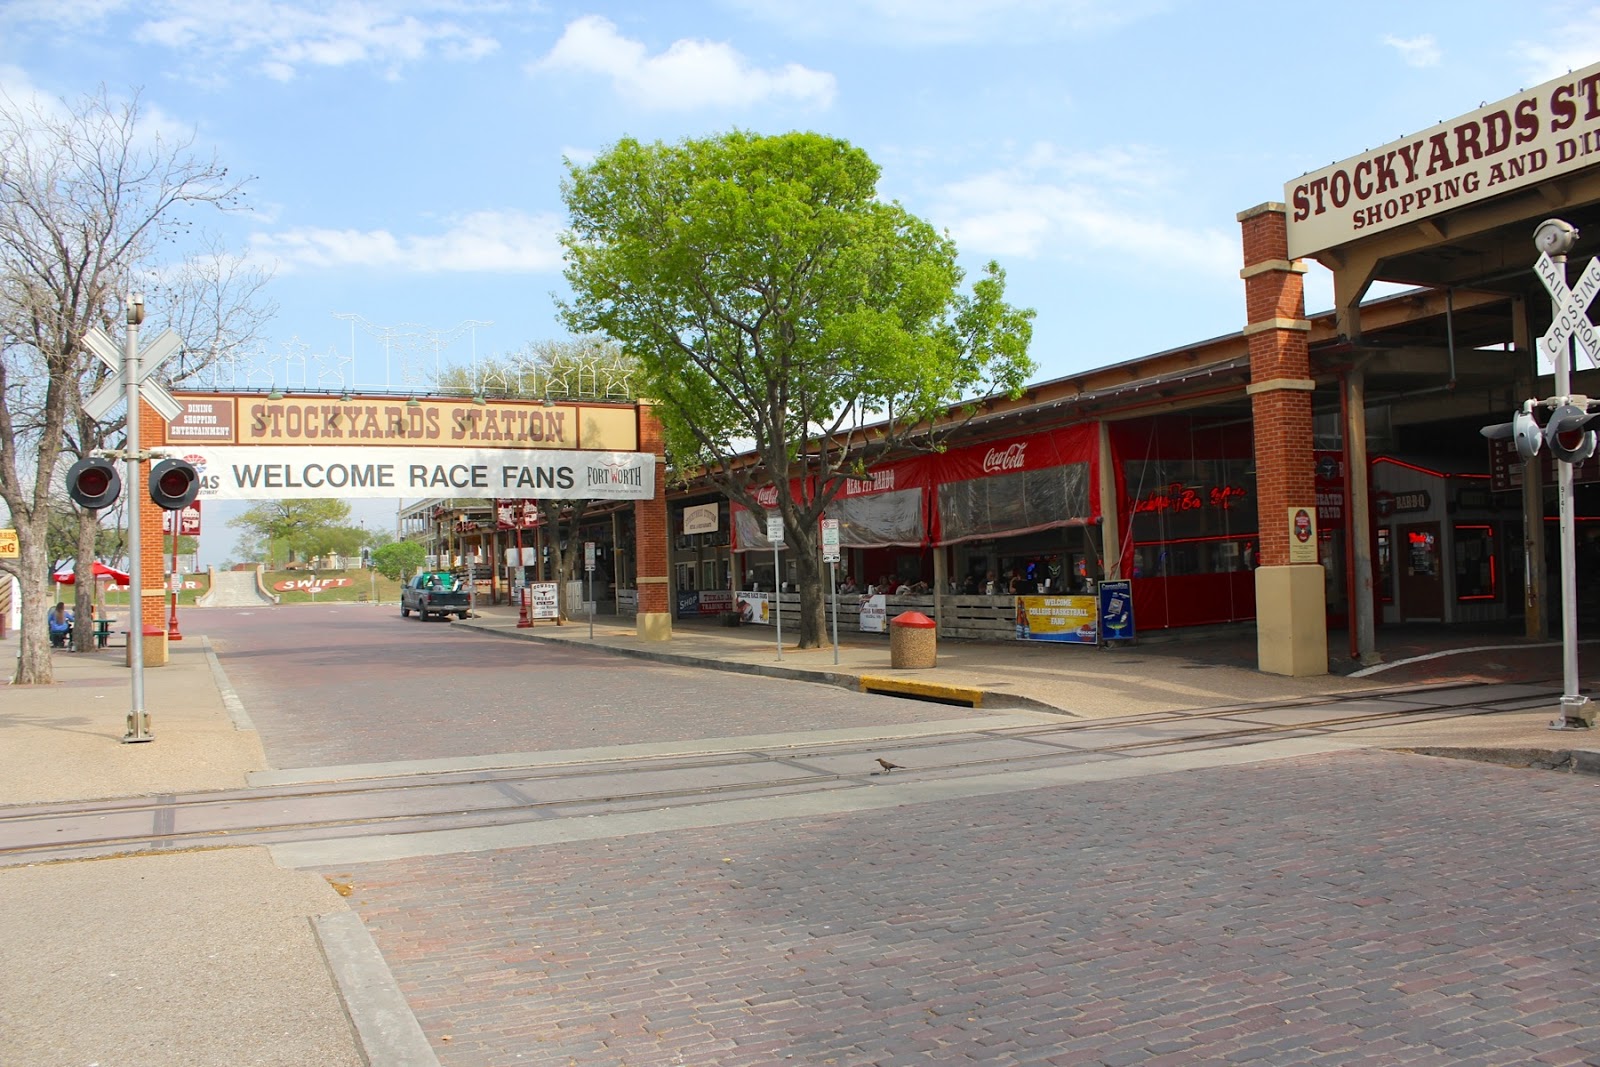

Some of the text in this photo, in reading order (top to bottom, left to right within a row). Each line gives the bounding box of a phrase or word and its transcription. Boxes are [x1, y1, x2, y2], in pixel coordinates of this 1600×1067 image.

[1292, 97, 1540, 223] STOCKYARDS
[1353, 171, 1480, 230] SHOPPING
[1487, 148, 1548, 188] AND
[1538, 258, 1565, 302] RAIL
[1547, 267, 1600, 354] CROSSING
[188, 404, 213, 413] DINING
[183, 415, 217, 425] SHOPPING
[250, 404, 565, 443] STOCKYARDS STATION
[171, 426, 230, 436] ENTERTAINMENT
[232, 463, 575, 490] WELCOME RACE FANS
[587, 466, 642, 487] FORT WORTH
[282, 578, 347, 589] SWIFT
[680, 595, 698, 610] SHOP
[1029, 608, 1088, 617] COLLEGE BASKETBALL
[1050, 617, 1065, 625] FANS
